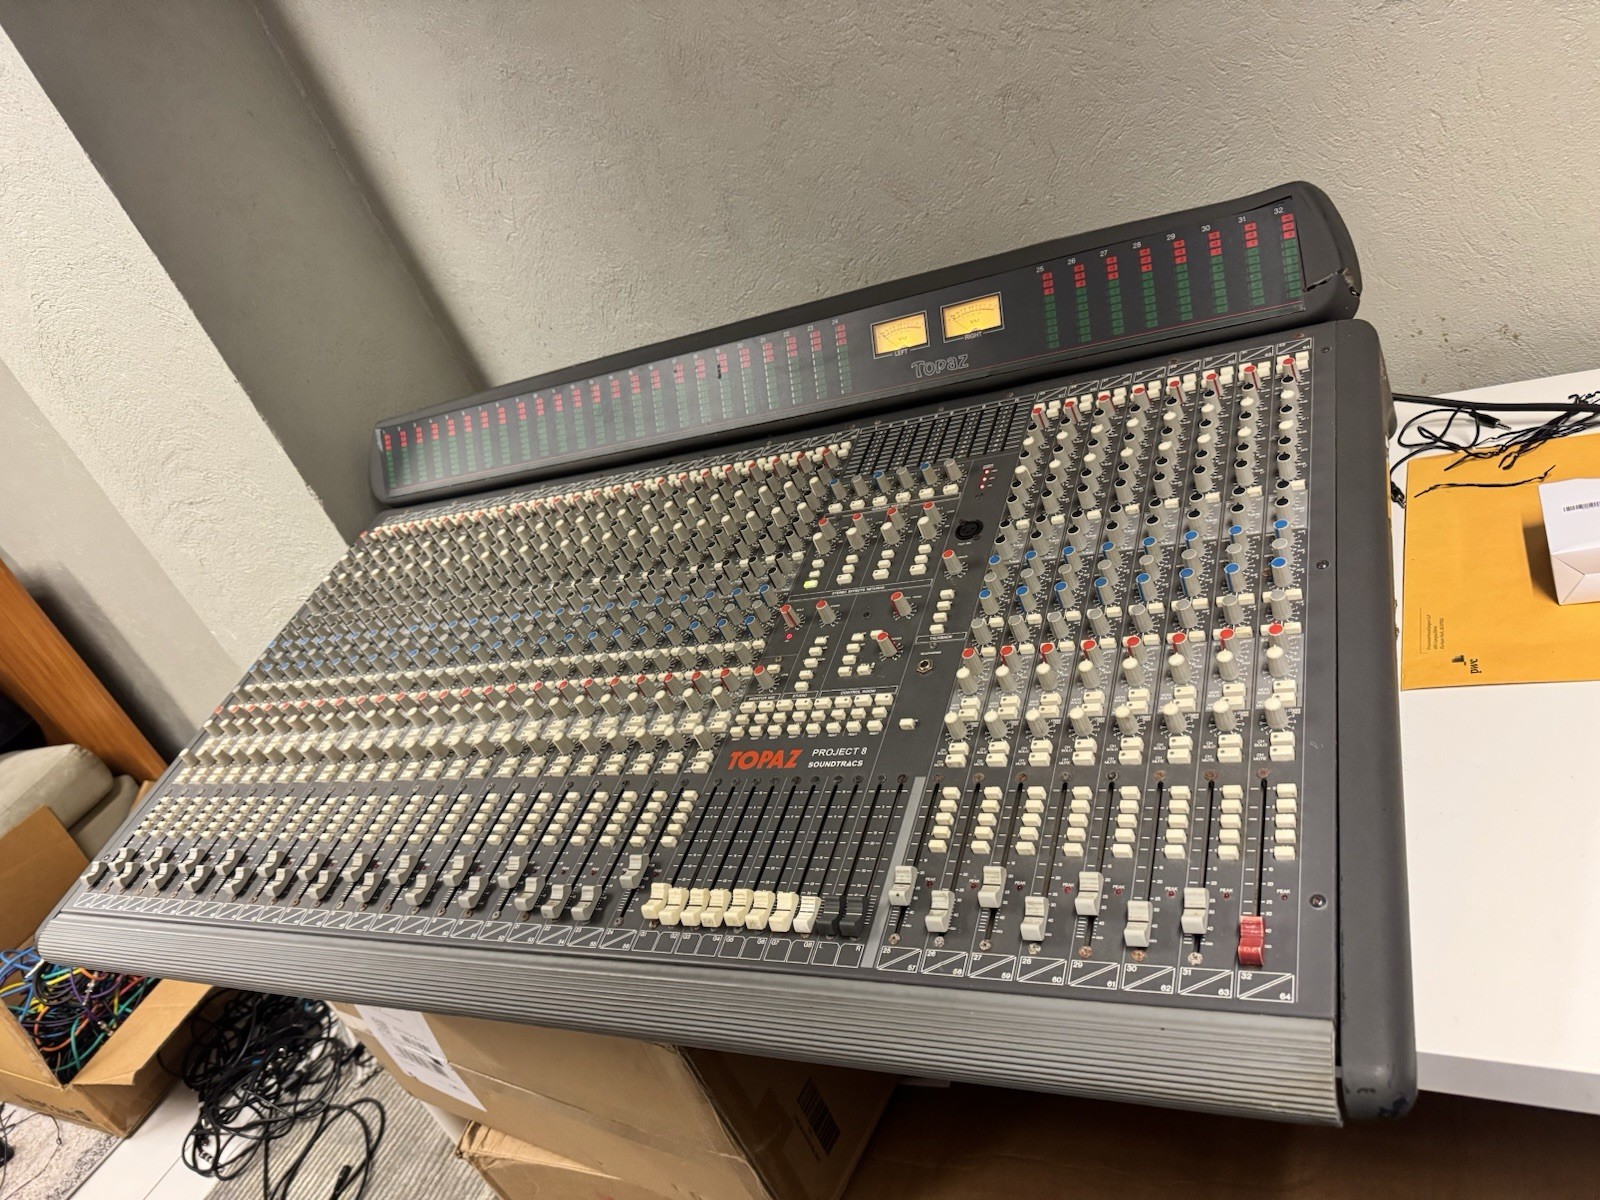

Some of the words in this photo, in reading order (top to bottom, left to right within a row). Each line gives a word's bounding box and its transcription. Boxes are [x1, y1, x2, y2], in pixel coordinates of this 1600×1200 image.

[1273, 207, 1284, 215] 32
[1238, 216, 1246, 224] 31
[1201, 224, 1211, 233] 30
[1166, 233, 1176, 241] 29
[1132, 241, 1142, 249] 28
[1100, 249, 1108, 257] 27
[1067, 258, 1076, 266] 26
[964, 331, 983, 340] RIGHT
[894, 349, 908, 357] LEFT
[911, 354, 969, 378] Topaz
[1469, 658, 1482, 674] pwc
[811, 747, 858, 757] PROJECT
[860, 746, 868, 755] 8
[727, 749, 803, 771] TOPAZ
[807, 760, 864, 768] SOUNDTRACS
